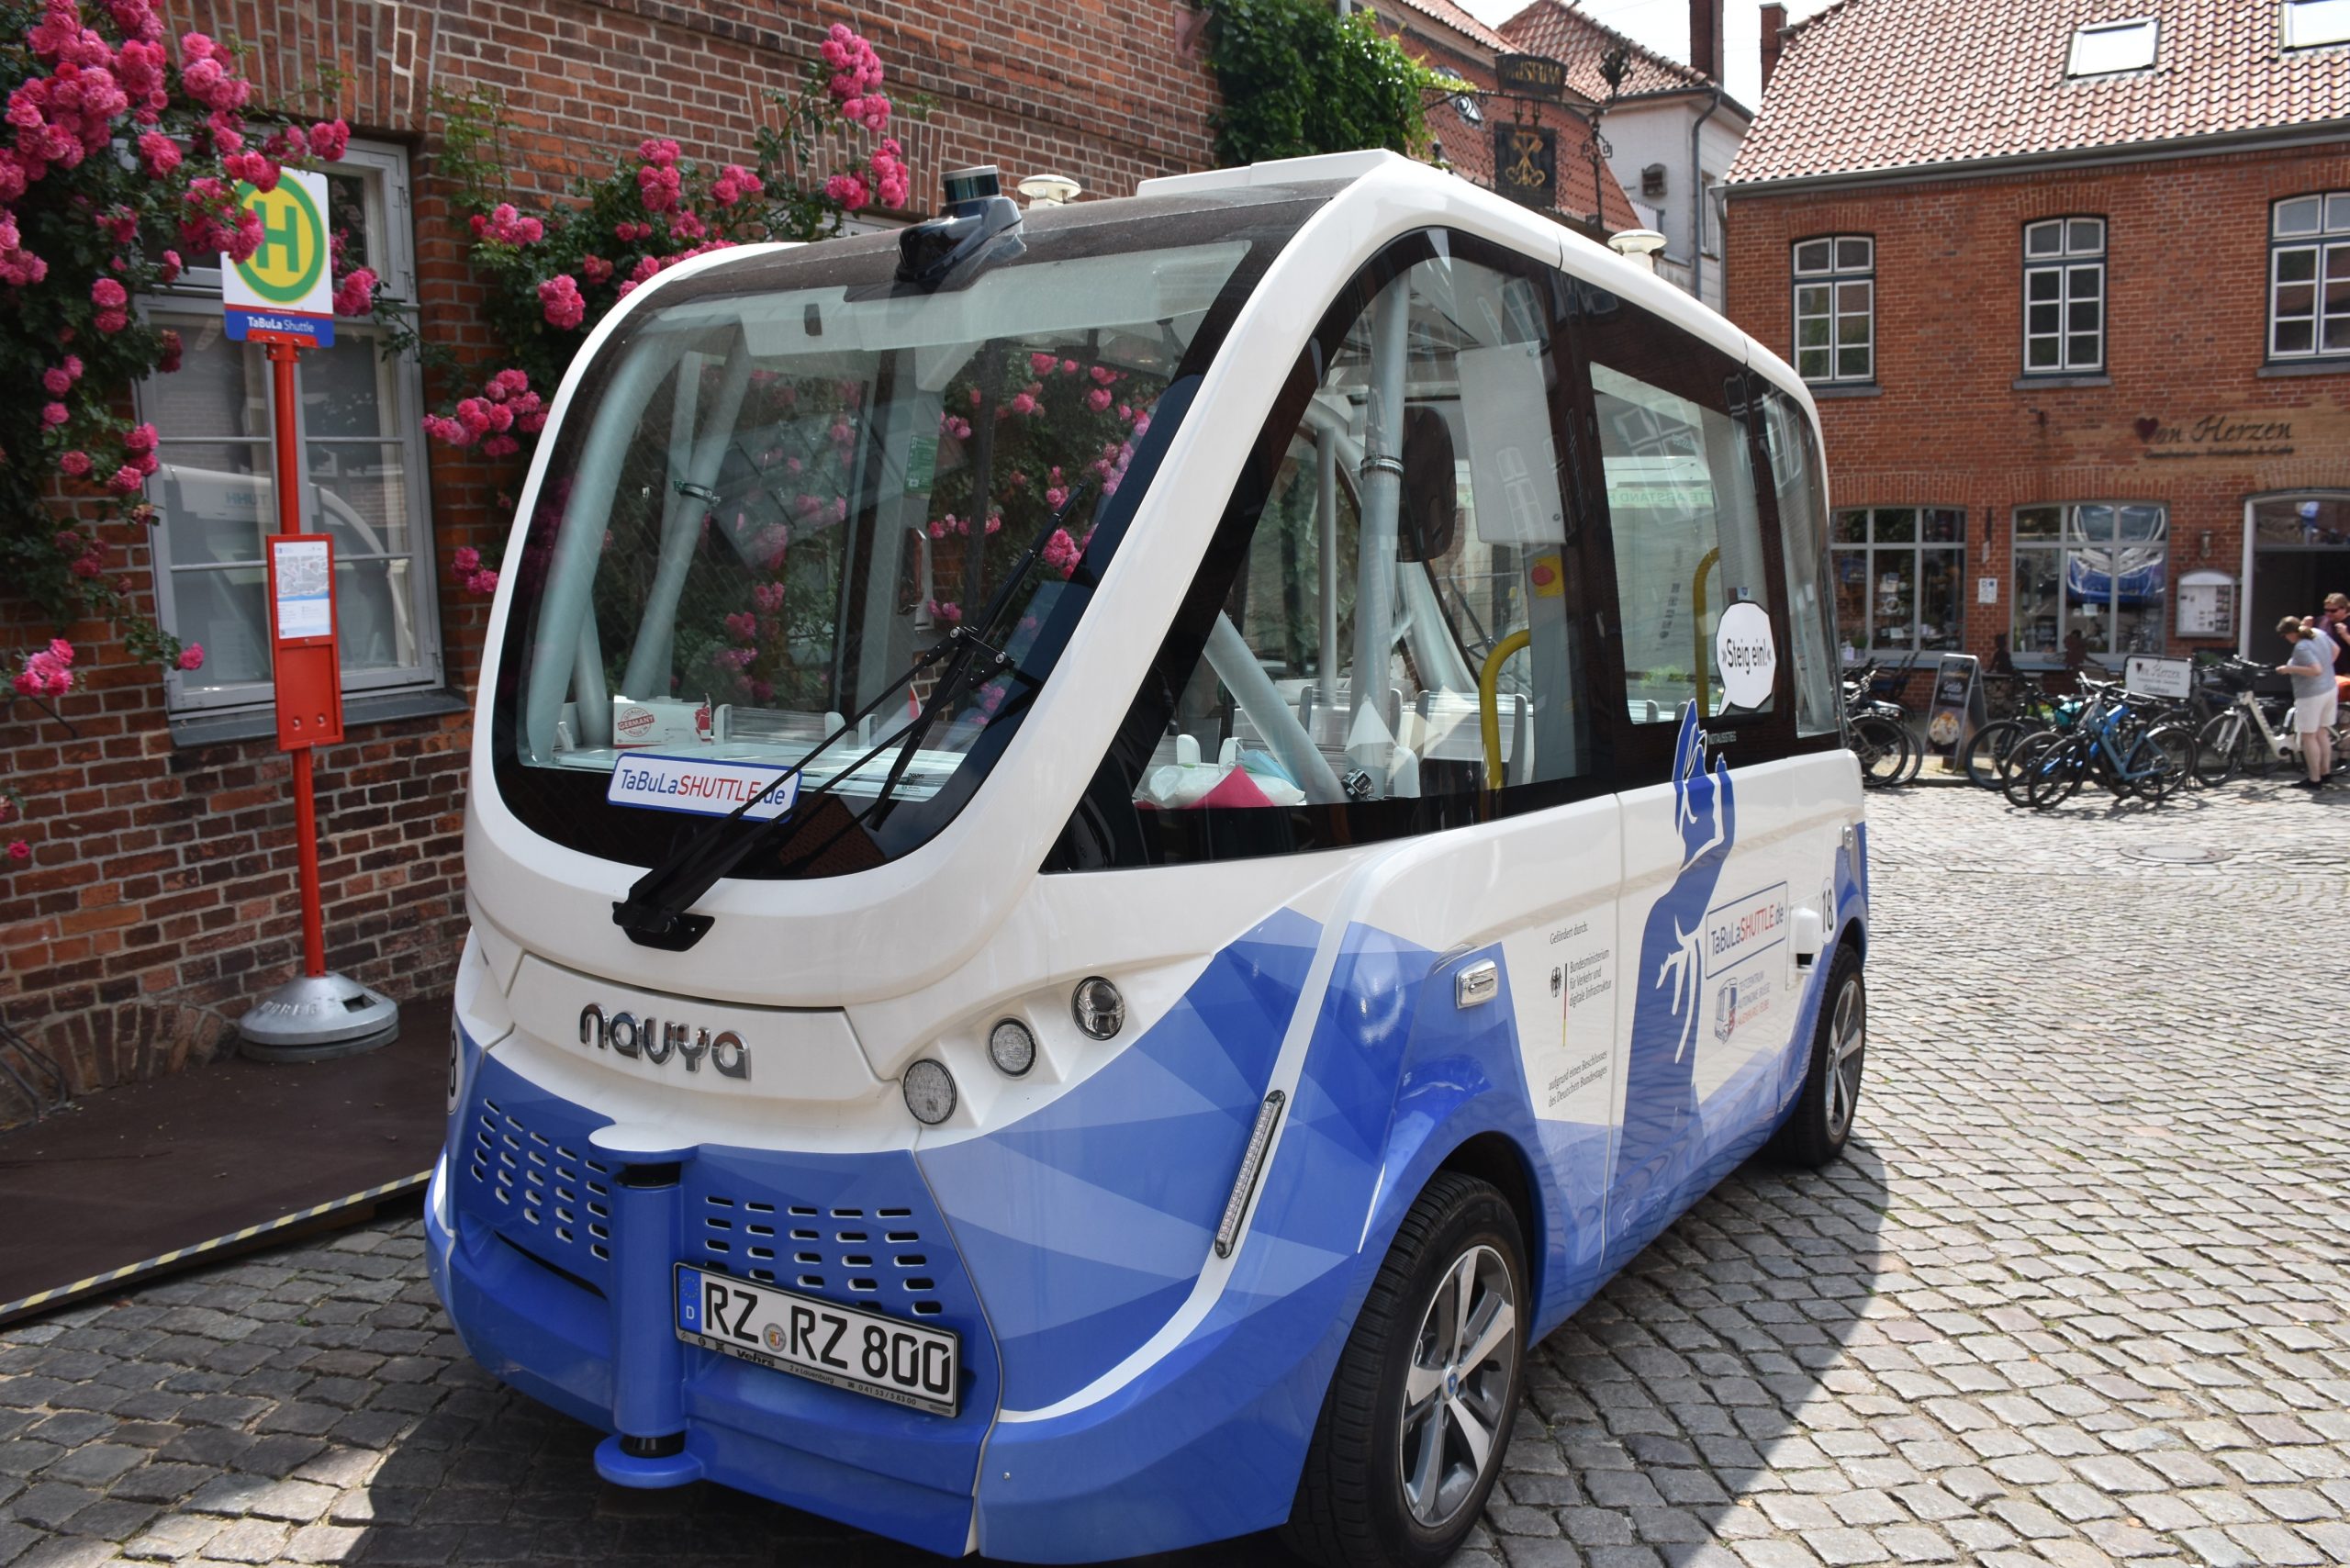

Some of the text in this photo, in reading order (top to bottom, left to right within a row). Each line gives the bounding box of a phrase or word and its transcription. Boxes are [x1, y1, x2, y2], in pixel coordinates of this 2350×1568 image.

[246, 316, 315, 333] TaBuLa Shuttle
[2192, 415, 2293, 442] Herzen
[619, 715, 655, 731] GERMANY
[621, 768, 786, 806] TaBuLaSHUTTLE.de
[1822, 889, 1834, 934] 18
[1550, 927, 1573, 945] Gefördert
[1710, 901, 1785, 957] TaBuLaSHUTTLE.de
[1570, 948, 1610, 974] Bundesministerium
[1576, 970, 1593, 987] Verkehr
[1593, 965, 1602, 980] und
[1569, 979, 1612, 1009] digitale Infrastruktur
[1549, 1050, 1608, 1092] aufgrund eines Beschlusses
[1549, 1065, 1608, 1108] des Deutschen Bundestages
[686, 1305, 695, 1320] D
[705, 1282, 759, 1344] RZ
[790, 1305, 848, 1371] RZ
[862, 1325, 951, 1395] 800
[735, 1349, 775, 1368] Vehrs
[800, 1367, 835, 1385] Lauenburg
